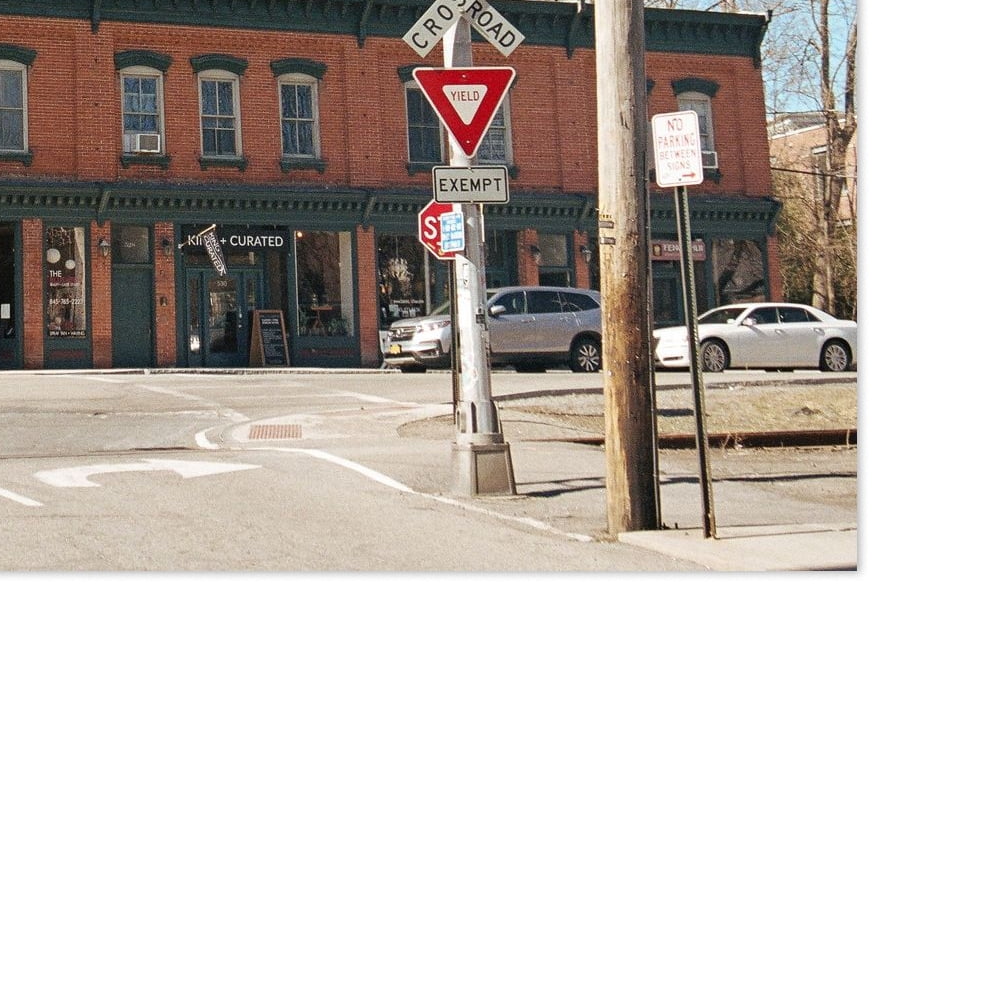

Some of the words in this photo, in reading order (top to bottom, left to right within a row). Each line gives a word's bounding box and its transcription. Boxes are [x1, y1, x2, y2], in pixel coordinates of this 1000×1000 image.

[465, 0, 516, 48] ROAD
[450, 90, 480, 102] YIELD
[667, 118, 684, 131] NO
[657, 132, 696, 148] PARKING
[659, 149, 697, 160] BETWEEN
[666, 160, 691, 170] SIGNS
[439, 178, 502, 192] EXEMPT
[229, 235, 284, 247] CURATED
